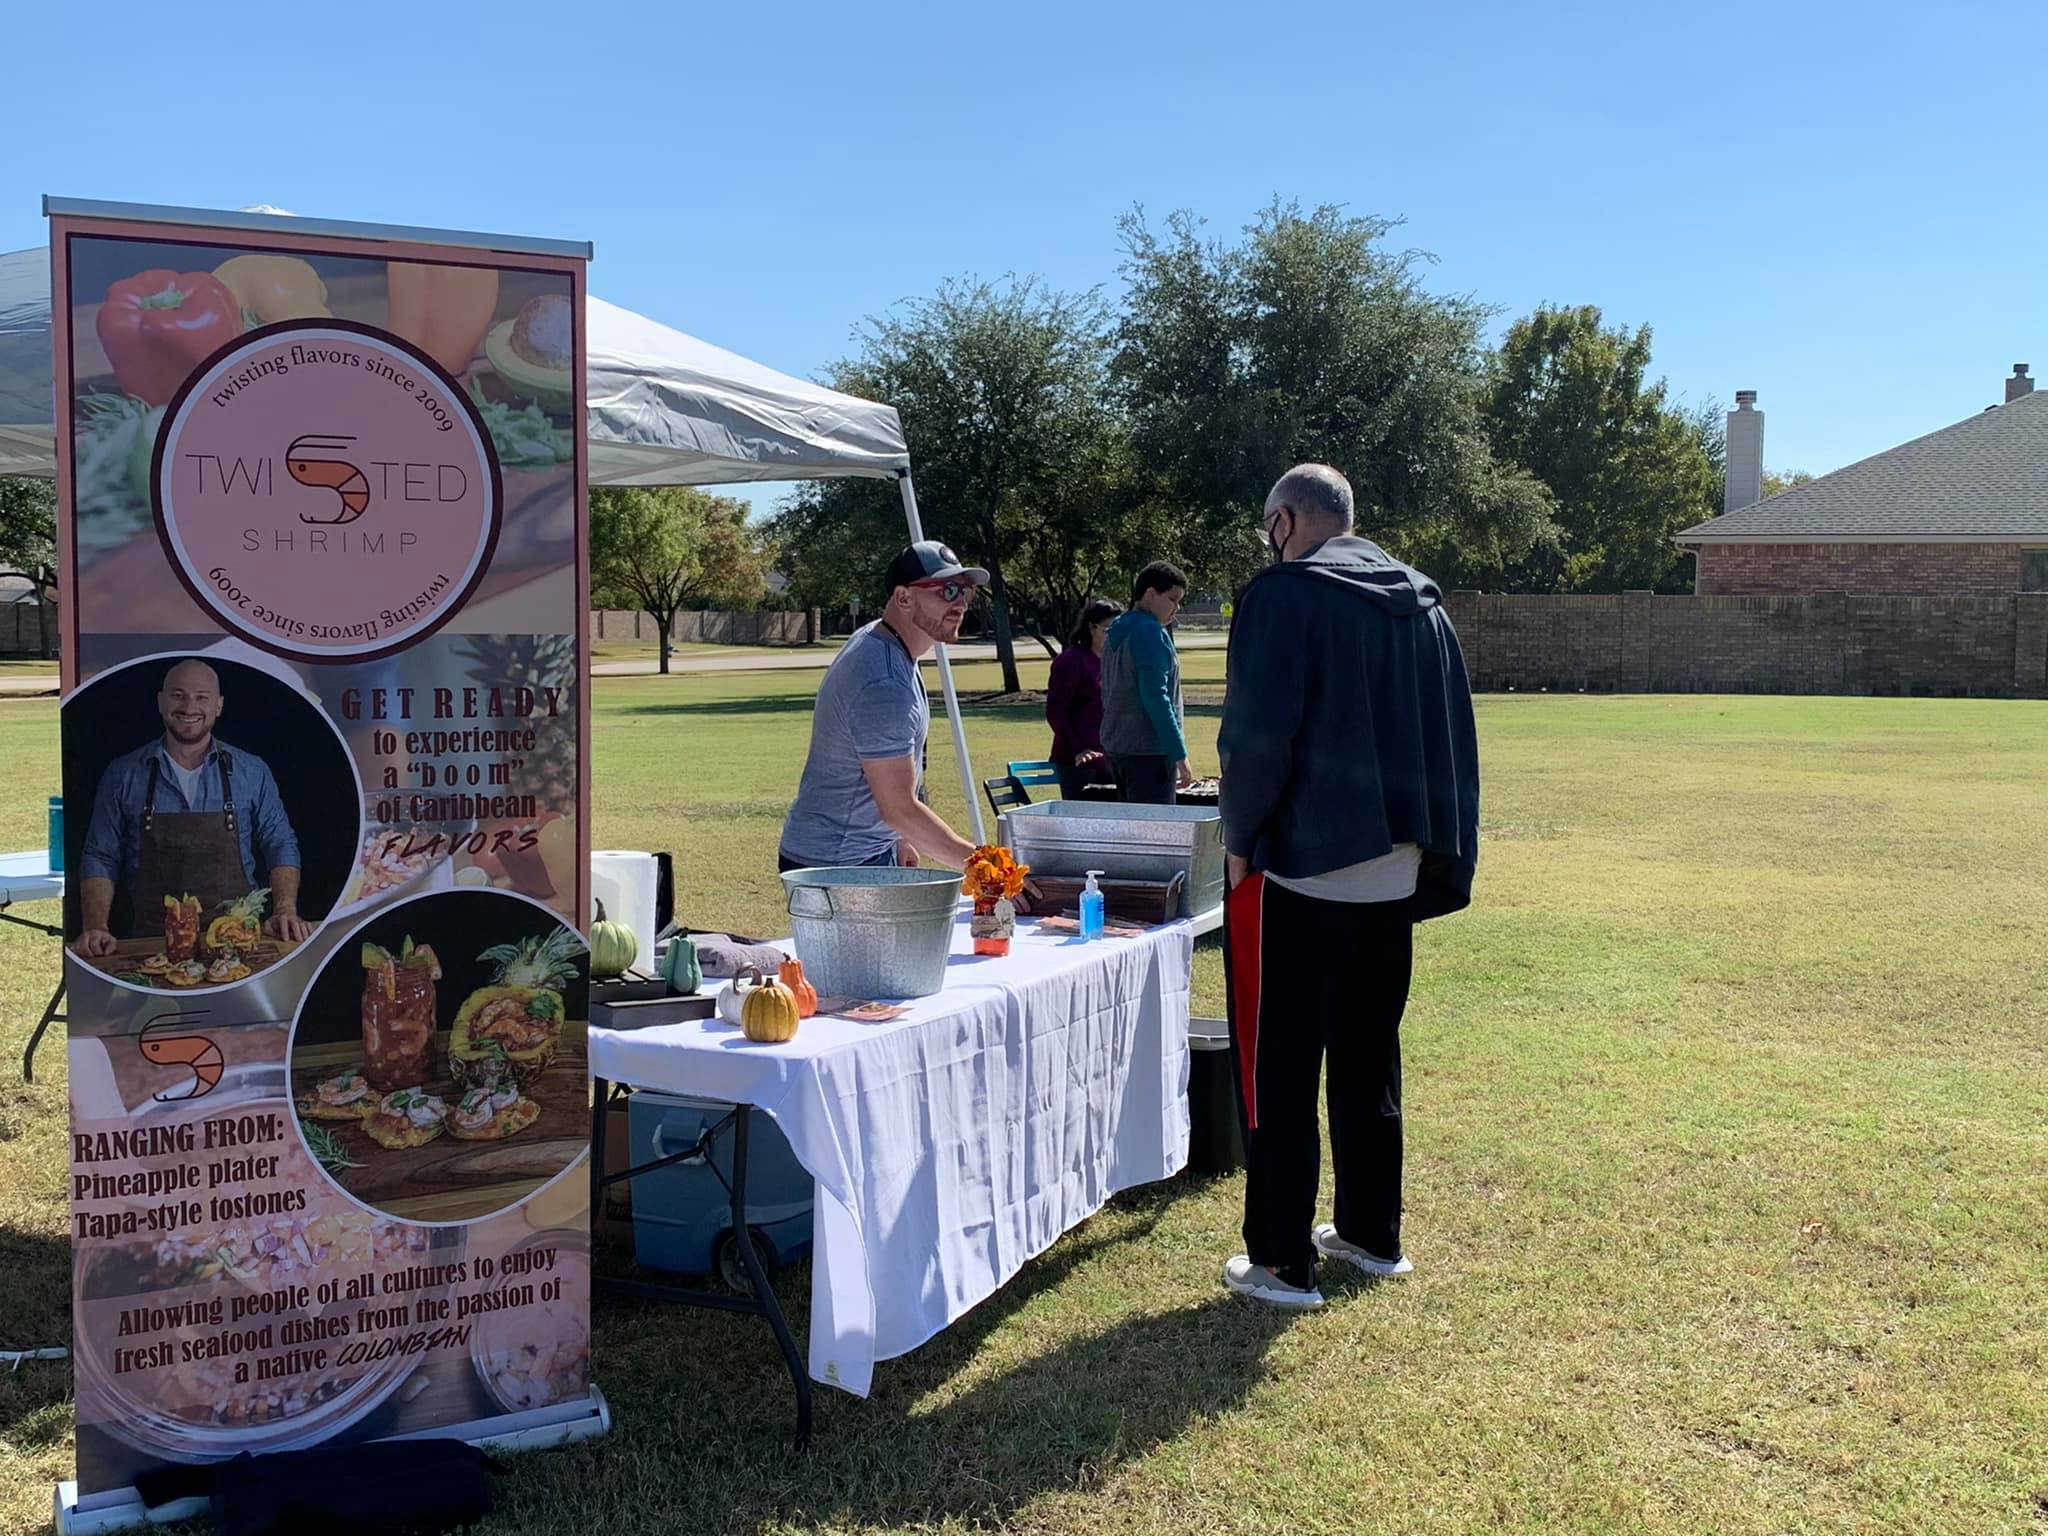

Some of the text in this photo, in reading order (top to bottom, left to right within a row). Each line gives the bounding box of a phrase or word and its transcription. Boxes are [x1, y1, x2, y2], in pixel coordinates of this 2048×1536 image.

[212, 346, 454, 432] twisting flavors since 2009
[242, 529, 418, 553] SHRIMP
[209, 566, 449, 641] twisting flavors since 2009
[341, 687, 562, 720] GET READY
[374, 727, 536, 757] to experience
[384, 765, 398, 789] a
[377, 793, 537, 823] of Caribbean
[380, 829, 539, 859] FLAVORS
[73, 1113, 284, 1163] RANGING FROM:
[74, 1155, 279, 1200] Pineapple plater
[75, 1188, 306, 1239] Tapa-style tostones
[118, 1247, 557, 1337] Allowing people of all cultures to enjoy
[114, 1277, 561, 1374] fresh seafood dishes from the passion of
[234, 1325, 472, 1384] a native COLOMBIAN
